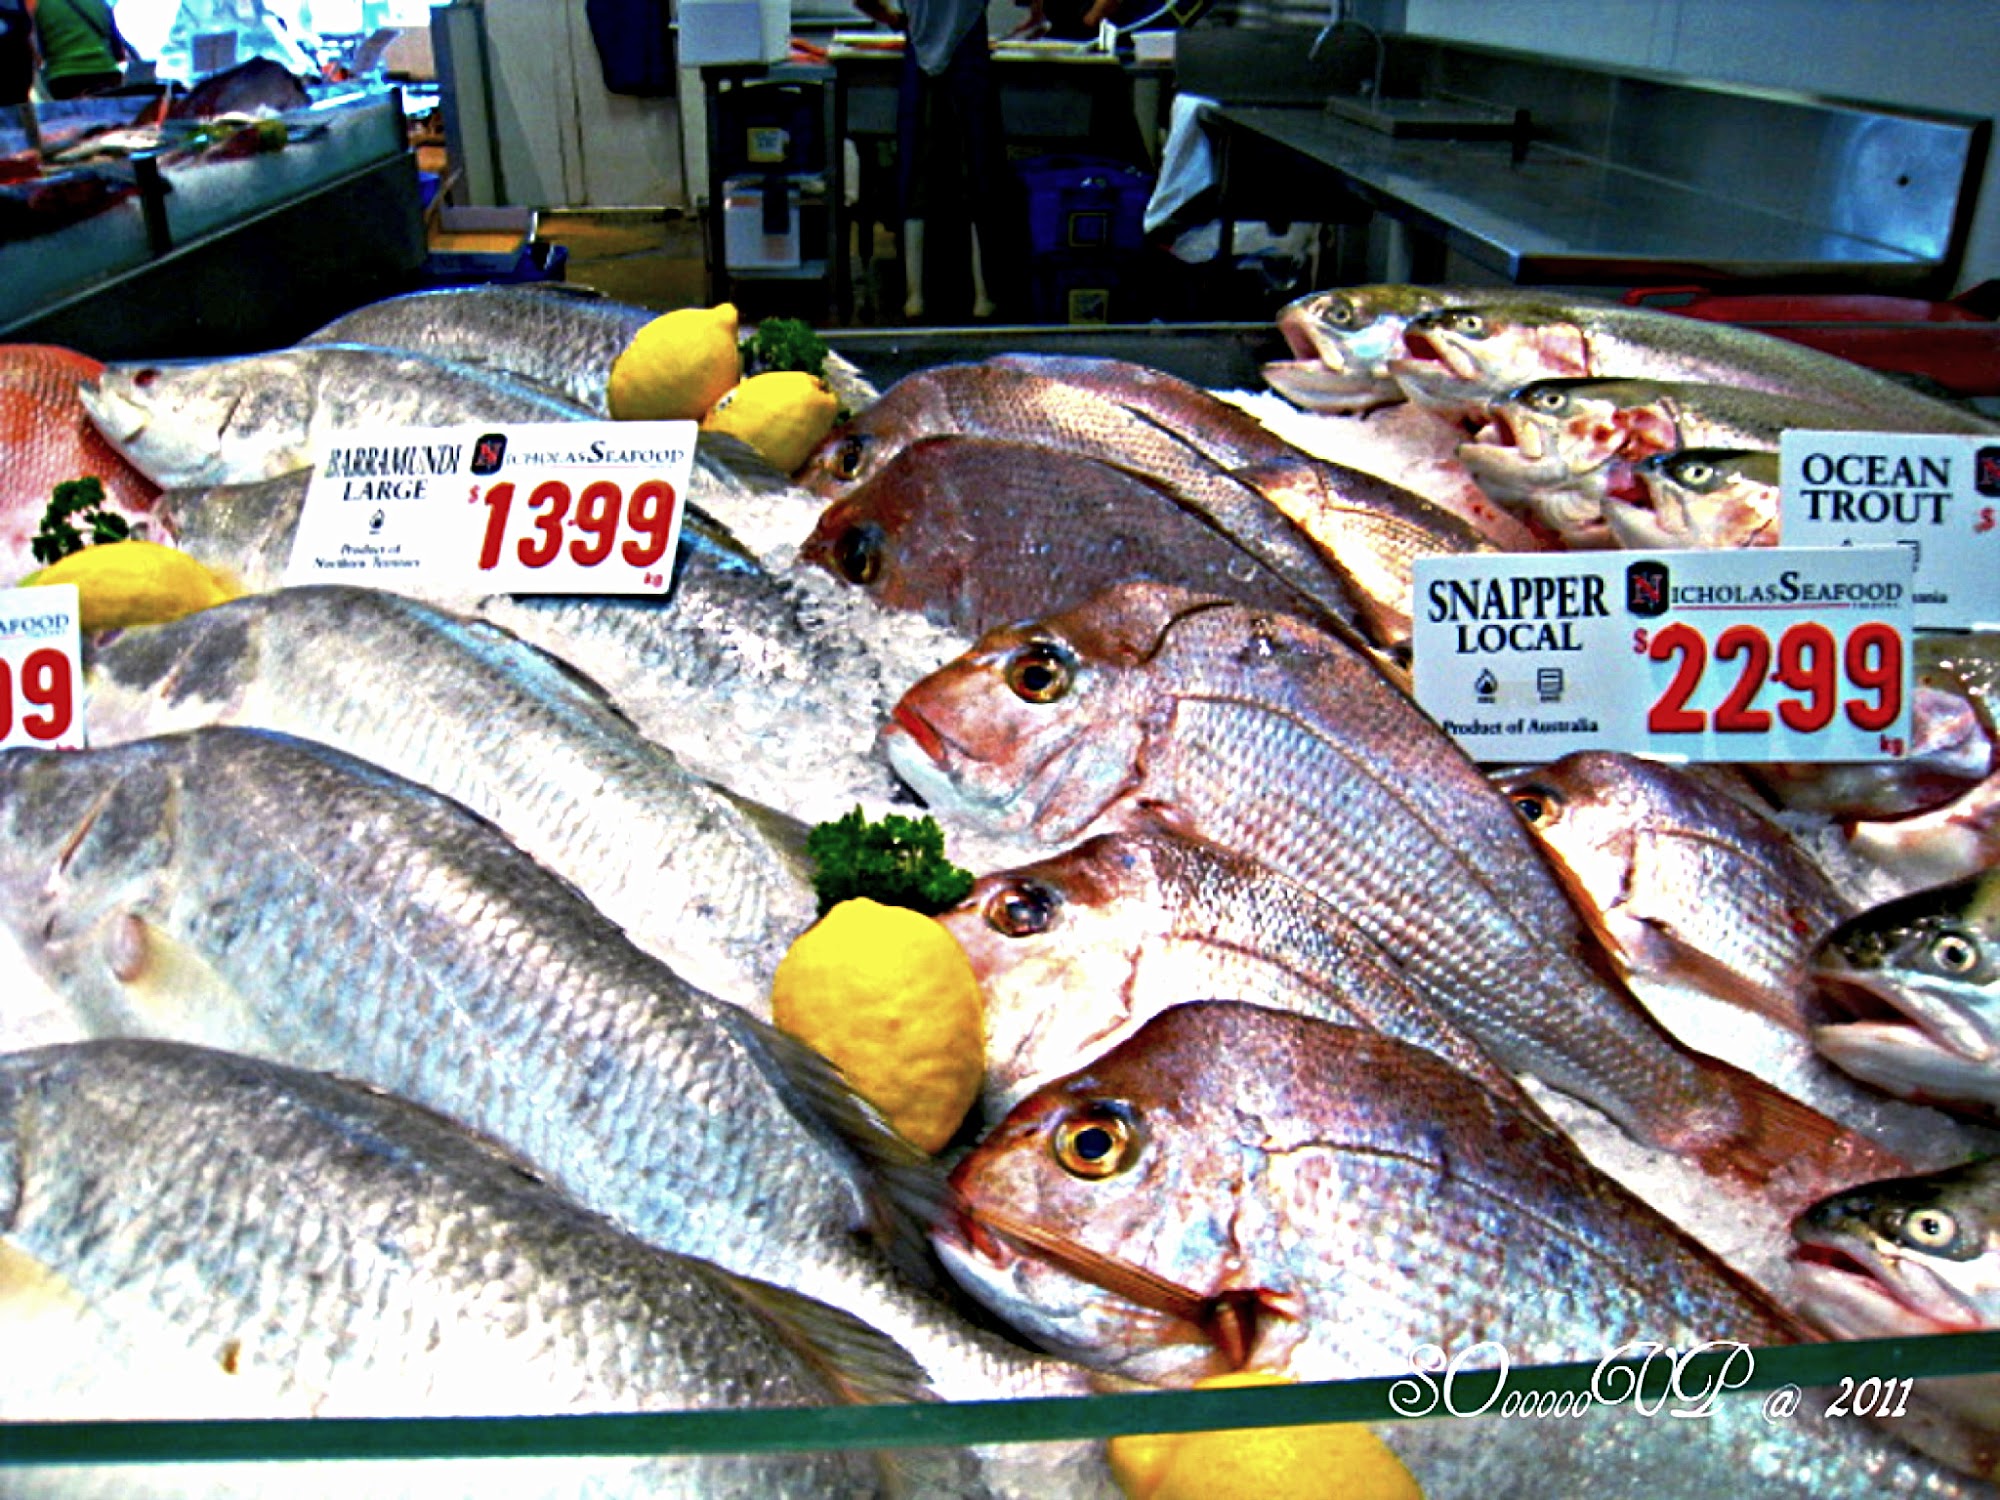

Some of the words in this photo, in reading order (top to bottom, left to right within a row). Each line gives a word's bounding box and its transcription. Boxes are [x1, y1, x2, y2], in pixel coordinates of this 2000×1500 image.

[325, 444, 462, 478] BARRAMUNDI
[1802, 453, 1951, 487] OCEAN
[343, 479, 428, 501] LARGE
[1800, 490, 1953, 524] TROUT
[1428, 574, 1610, 623] SNAPPER
[1456, 621, 1583, 654] LOCAL
[1443, 718, 1501, 735] Product
[1505, 718, 1524, 735] of
[1527, 717, 1598, 734] Australia
